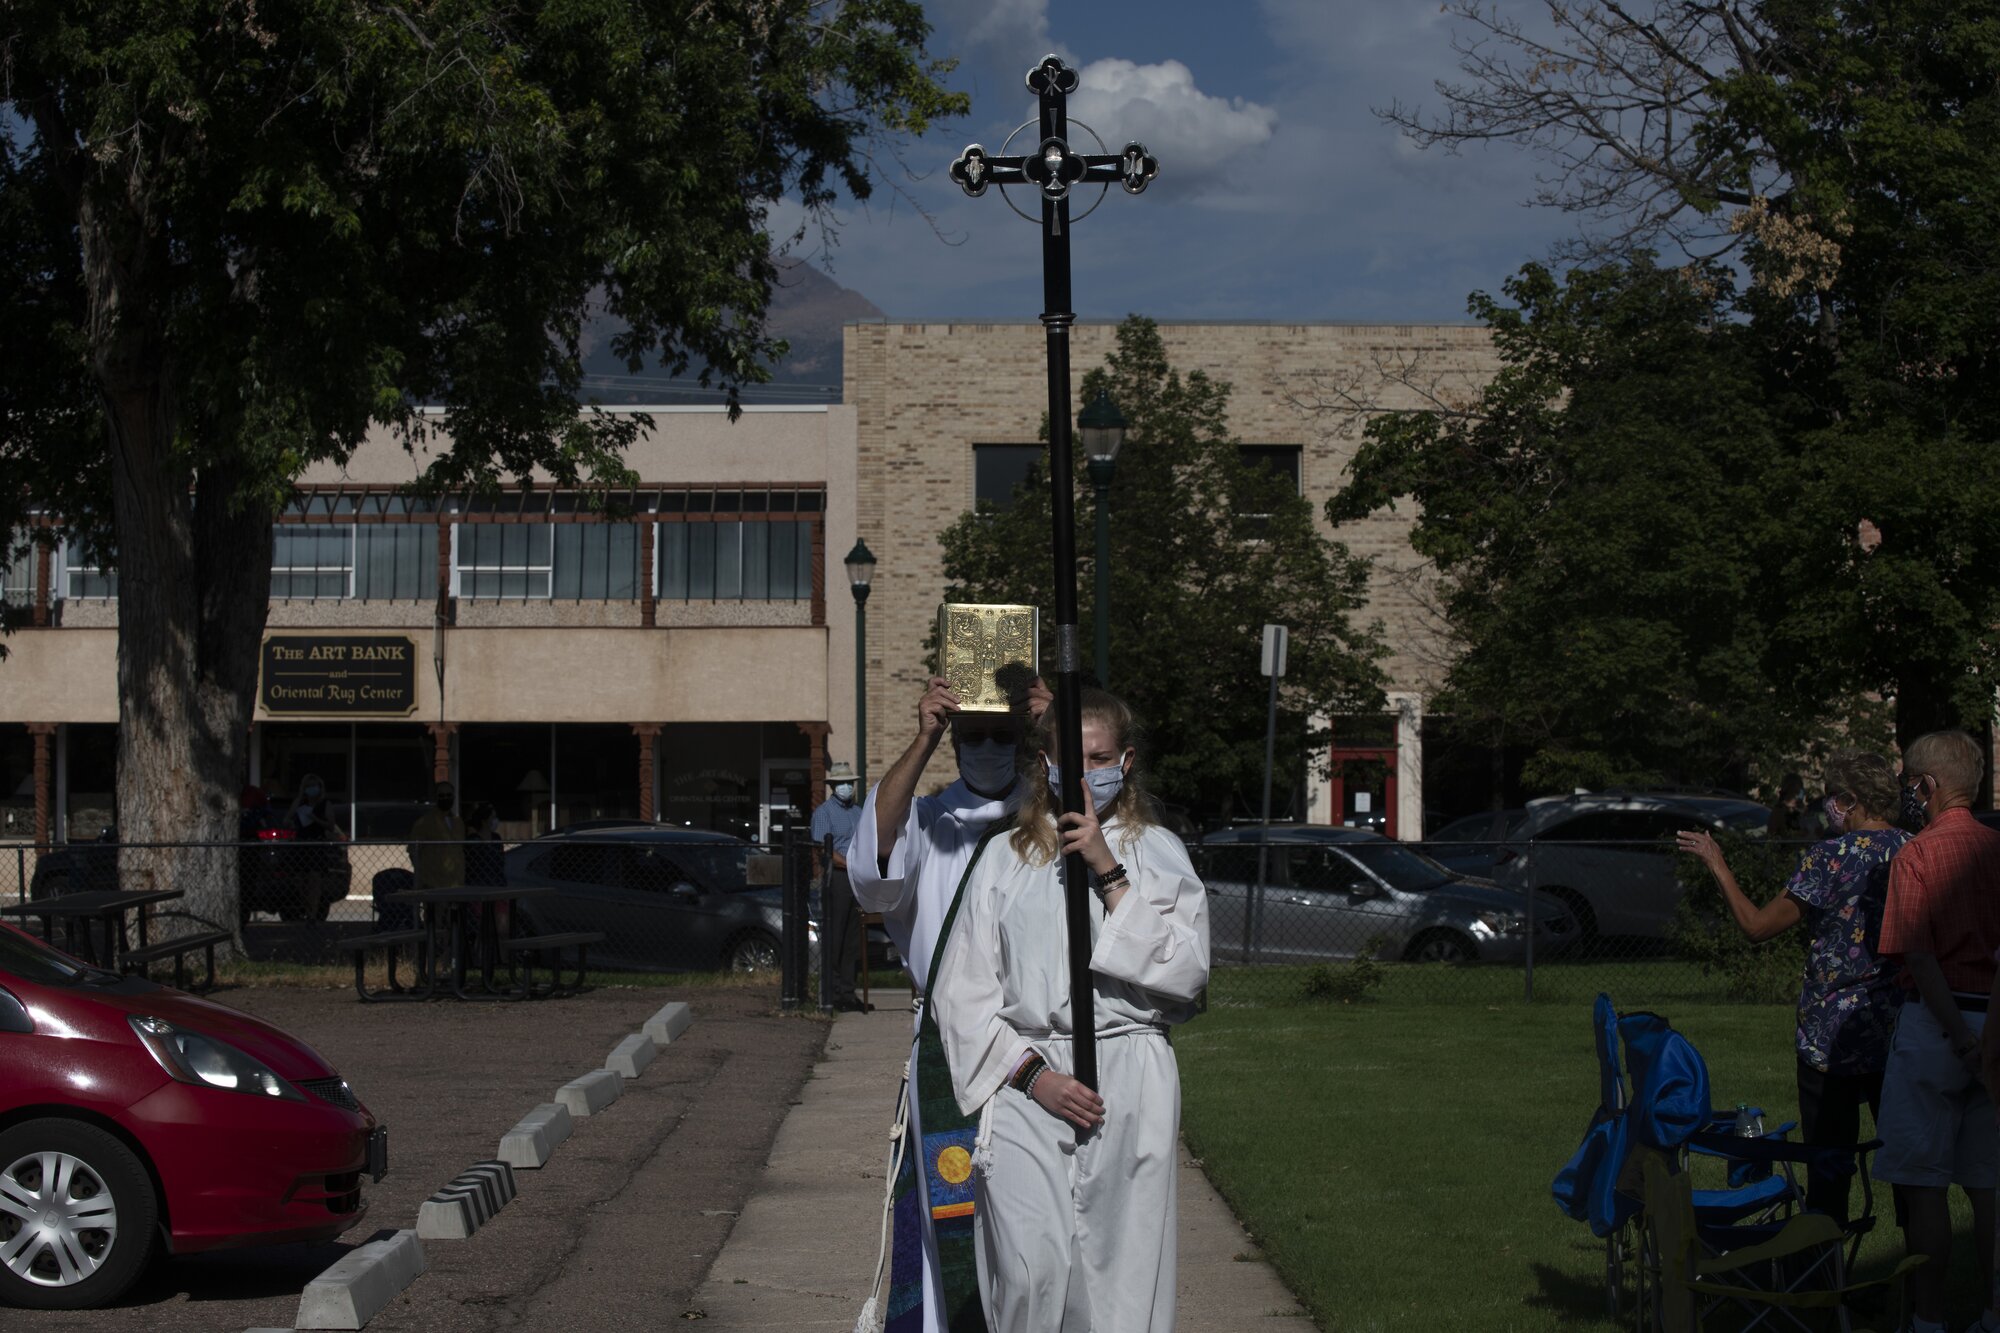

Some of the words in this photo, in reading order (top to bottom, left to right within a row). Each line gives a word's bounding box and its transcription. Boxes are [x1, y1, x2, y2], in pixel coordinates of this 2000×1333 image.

[308, 646, 346, 660] ART
[351, 646, 406, 660] BANK
[328, 669, 348, 679] and
[270, 684, 325, 699] Oriental
[327, 684, 356, 705] Rug
[360, 684, 404, 699] Center
